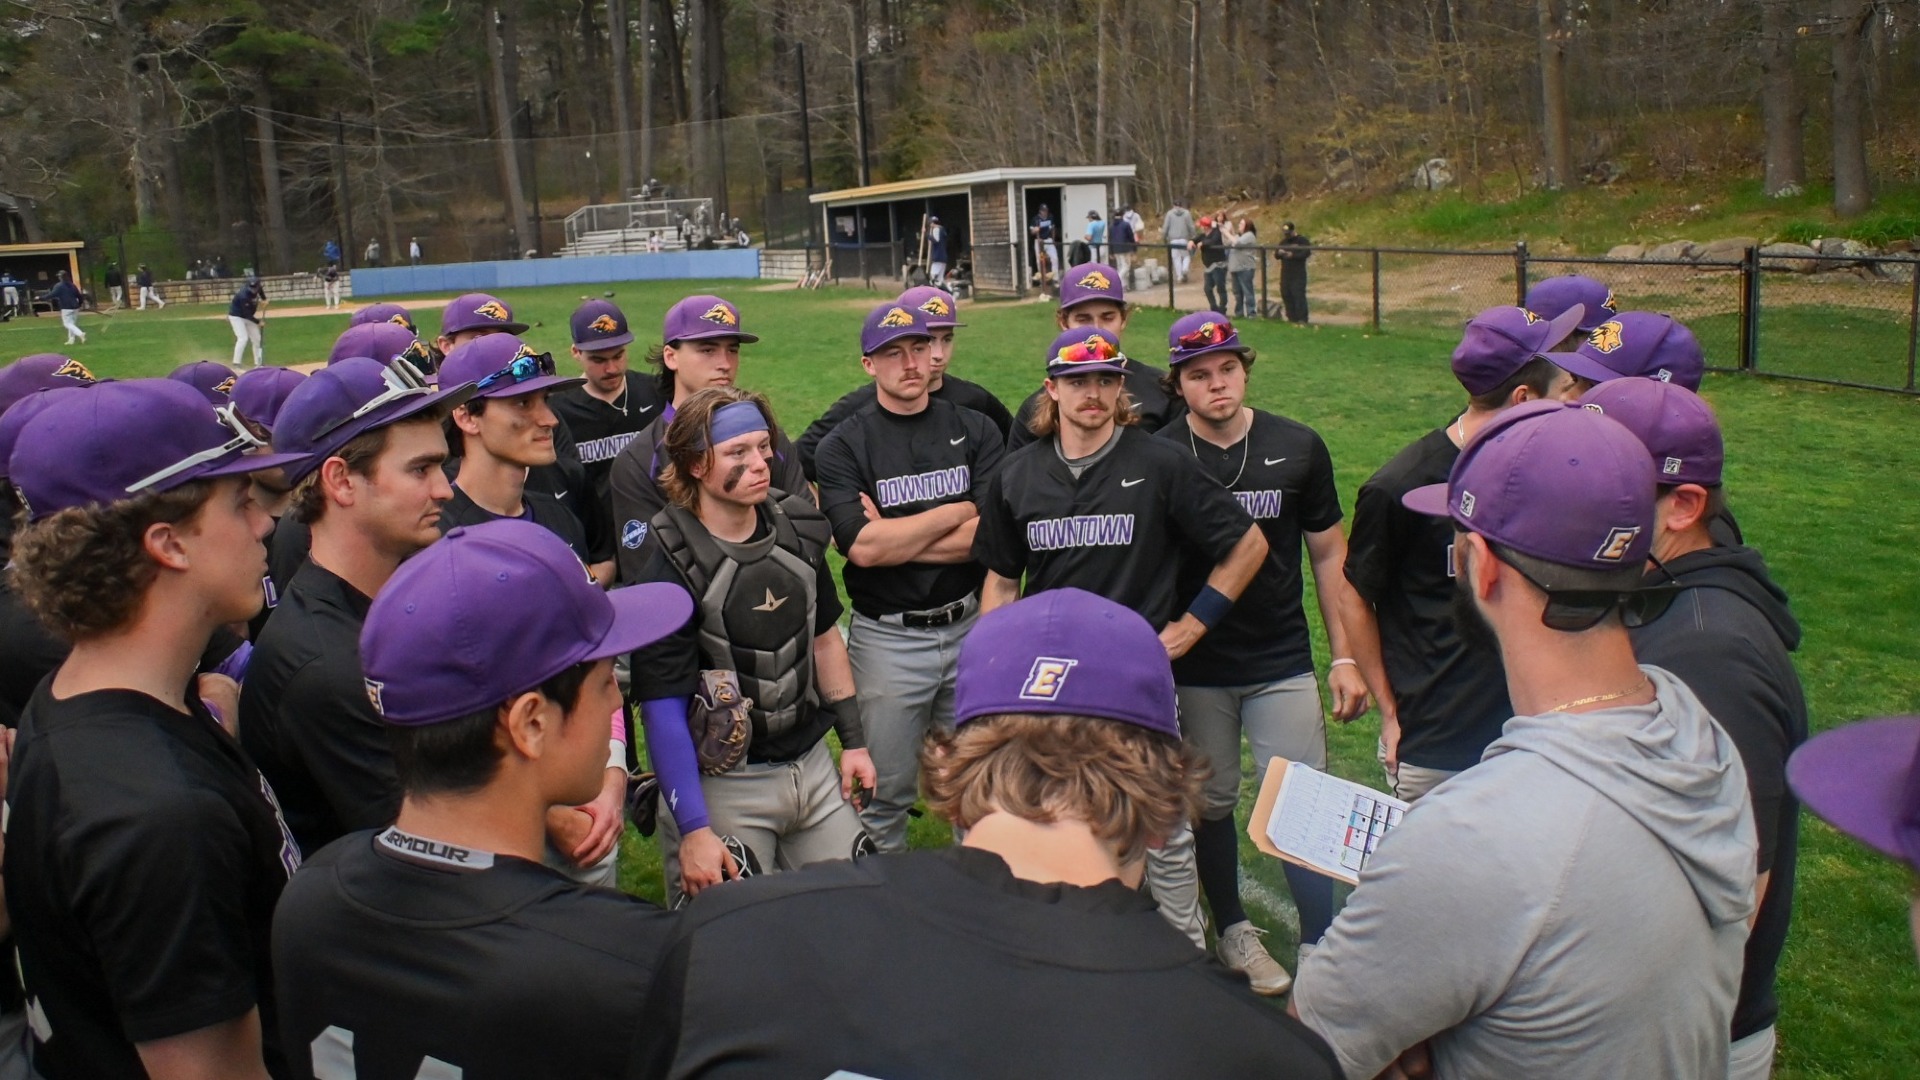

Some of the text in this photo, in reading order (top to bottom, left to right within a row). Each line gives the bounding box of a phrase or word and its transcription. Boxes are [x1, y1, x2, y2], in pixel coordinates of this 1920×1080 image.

[876, 465, 970, 507] DOWNTOWN
[1027, 514, 1135, 551] DOWNTOWN
[1596, 528, 1637, 560] E
[1022, 657, 1071, 700] E
[385, 831, 470, 863] ARMOUR
